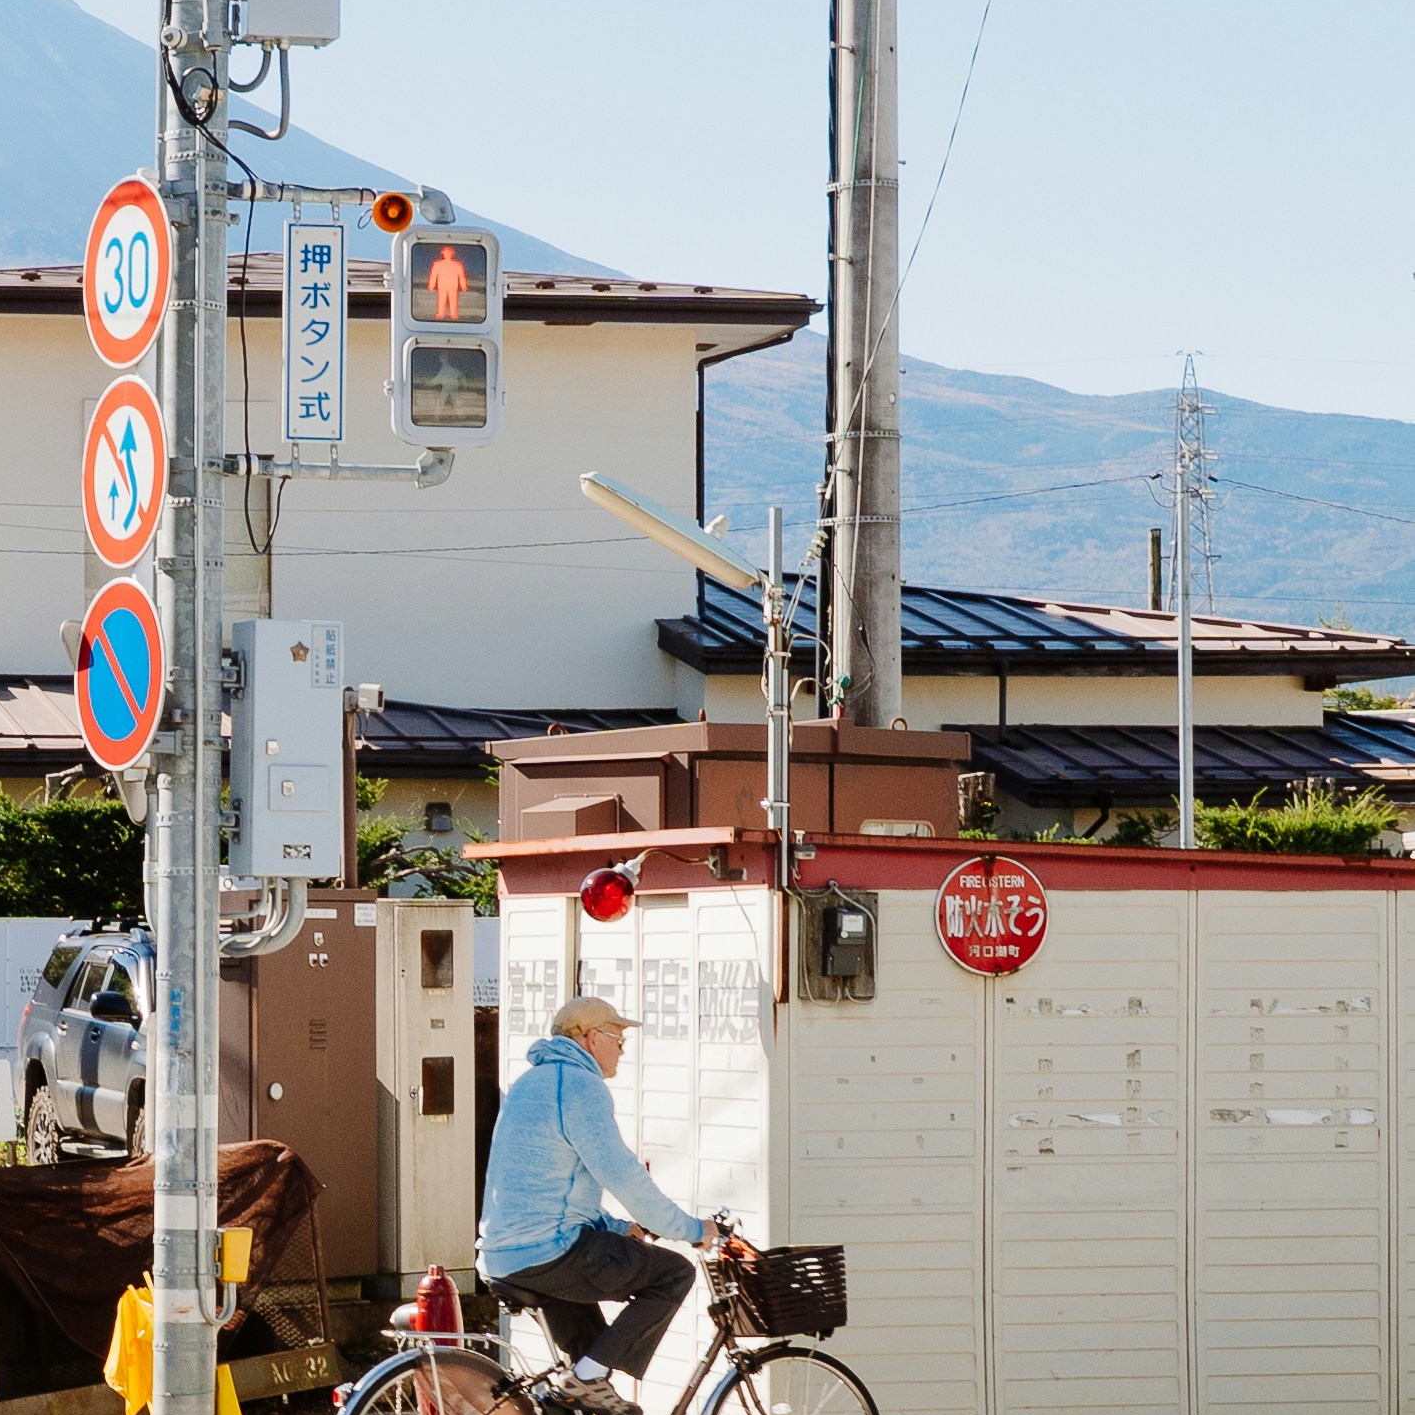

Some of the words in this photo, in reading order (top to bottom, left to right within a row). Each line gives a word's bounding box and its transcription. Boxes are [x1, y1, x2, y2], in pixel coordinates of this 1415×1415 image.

[103, 230, 151, 315] 30
[297, 242, 332, 424] 押ボタン式
[959, 874, 982, 889] FIRE
[968, 944, 1021, 958] 河口湖町
